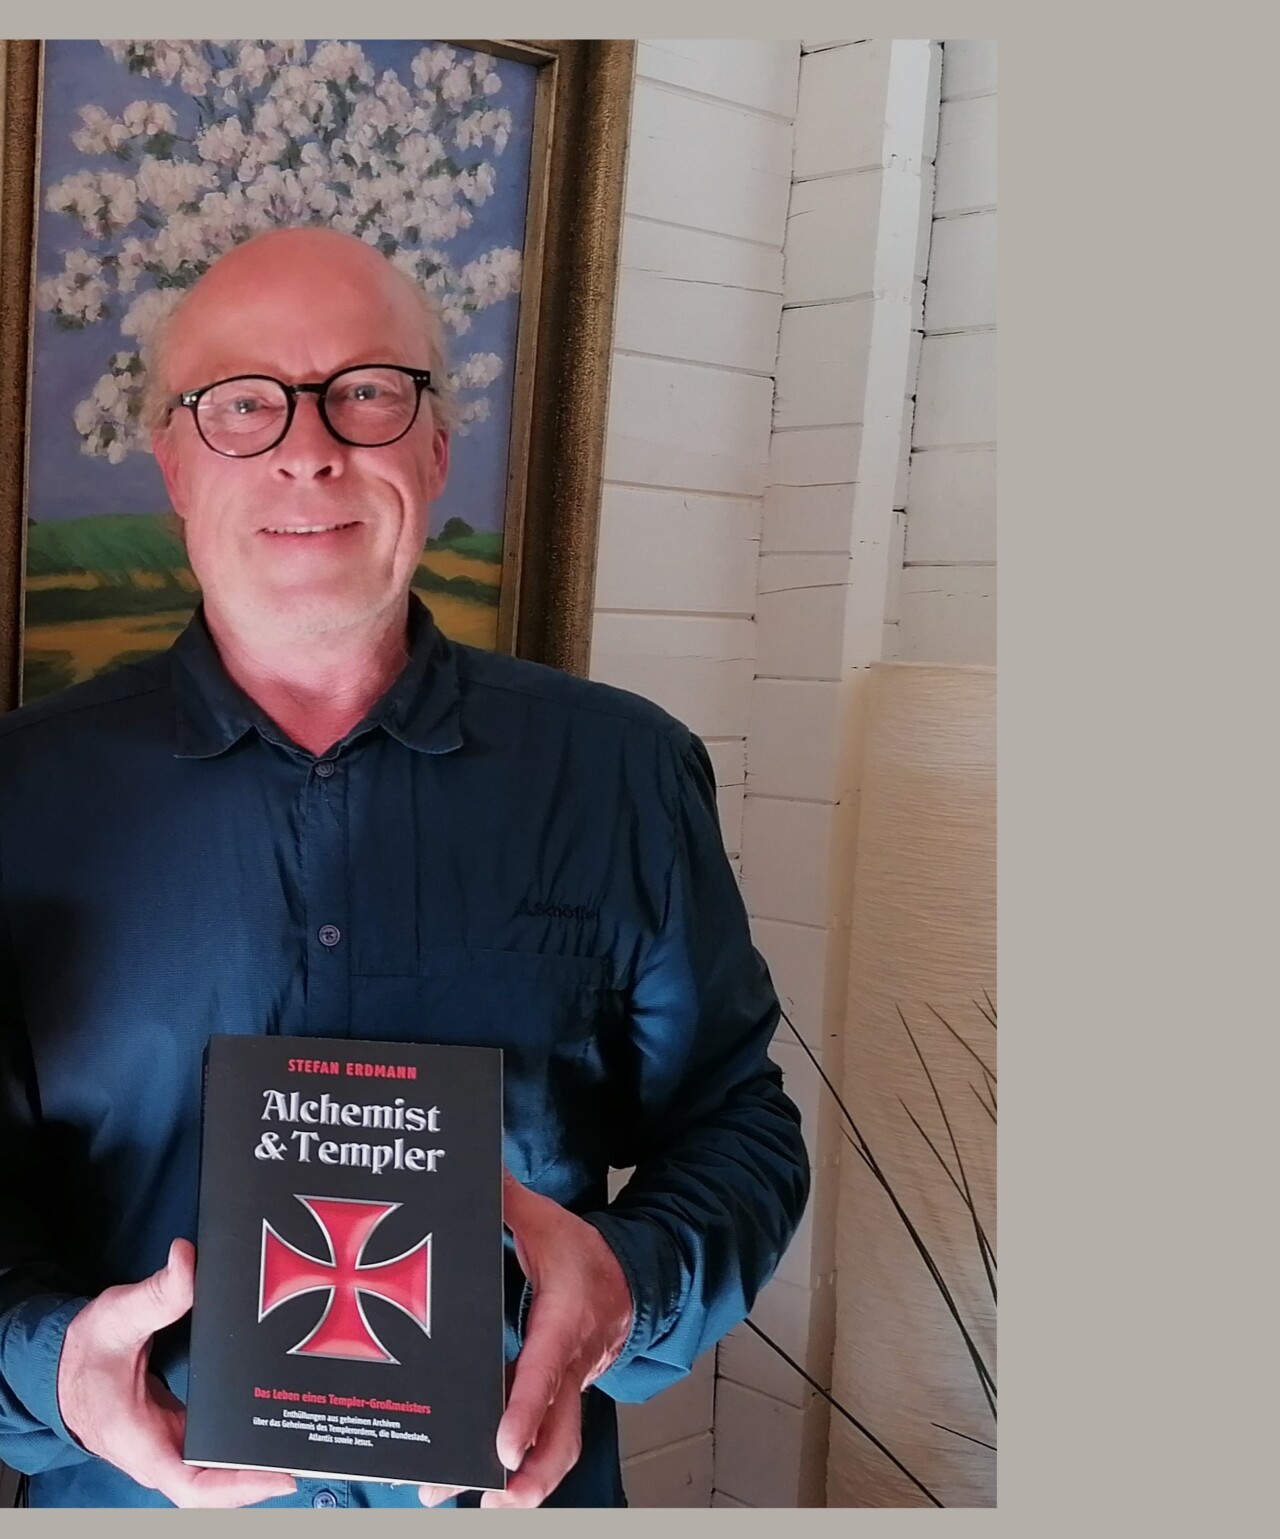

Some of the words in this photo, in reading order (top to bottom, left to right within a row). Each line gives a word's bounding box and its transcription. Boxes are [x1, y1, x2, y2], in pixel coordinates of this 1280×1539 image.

[288, 1058, 340, 1075] STEFAN
[346, 1062, 417, 1080] ERDMANN
[260, 1089, 441, 1133] Alchemist
[254, 1131, 288, 1161] &
[291, 1130, 446, 1175] Templer
[254, 1386, 271, 1399] Das
[273, 1389, 300, 1401] Leben
[302, 1391, 326, 1404] eines
[328, 1393, 431, 1414] Templer-Großmeisters
[253, 1416, 269, 1426] über
[269, 1418, 281, 1427] das
[282, 1420, 315, 1431] Geheimnis
[316, 1423, 328, 1432] des
[328, 1424, 378, 1438] Templerordens,
[378, 1429, 390, 1438] die
[390, 1430, 431, 1443] Bundeslade,
[283, 1409, 326, 1422] Enthüllungen
[339, 1416, 372, 1425] geheimen
[372, 1418, 401, 1429] Archiven
[308, 1432, 334, 1443] Atlantis
[334, 1436, 354, 1445] sowie
[353, 1437, 374, 1447] Jesus.
